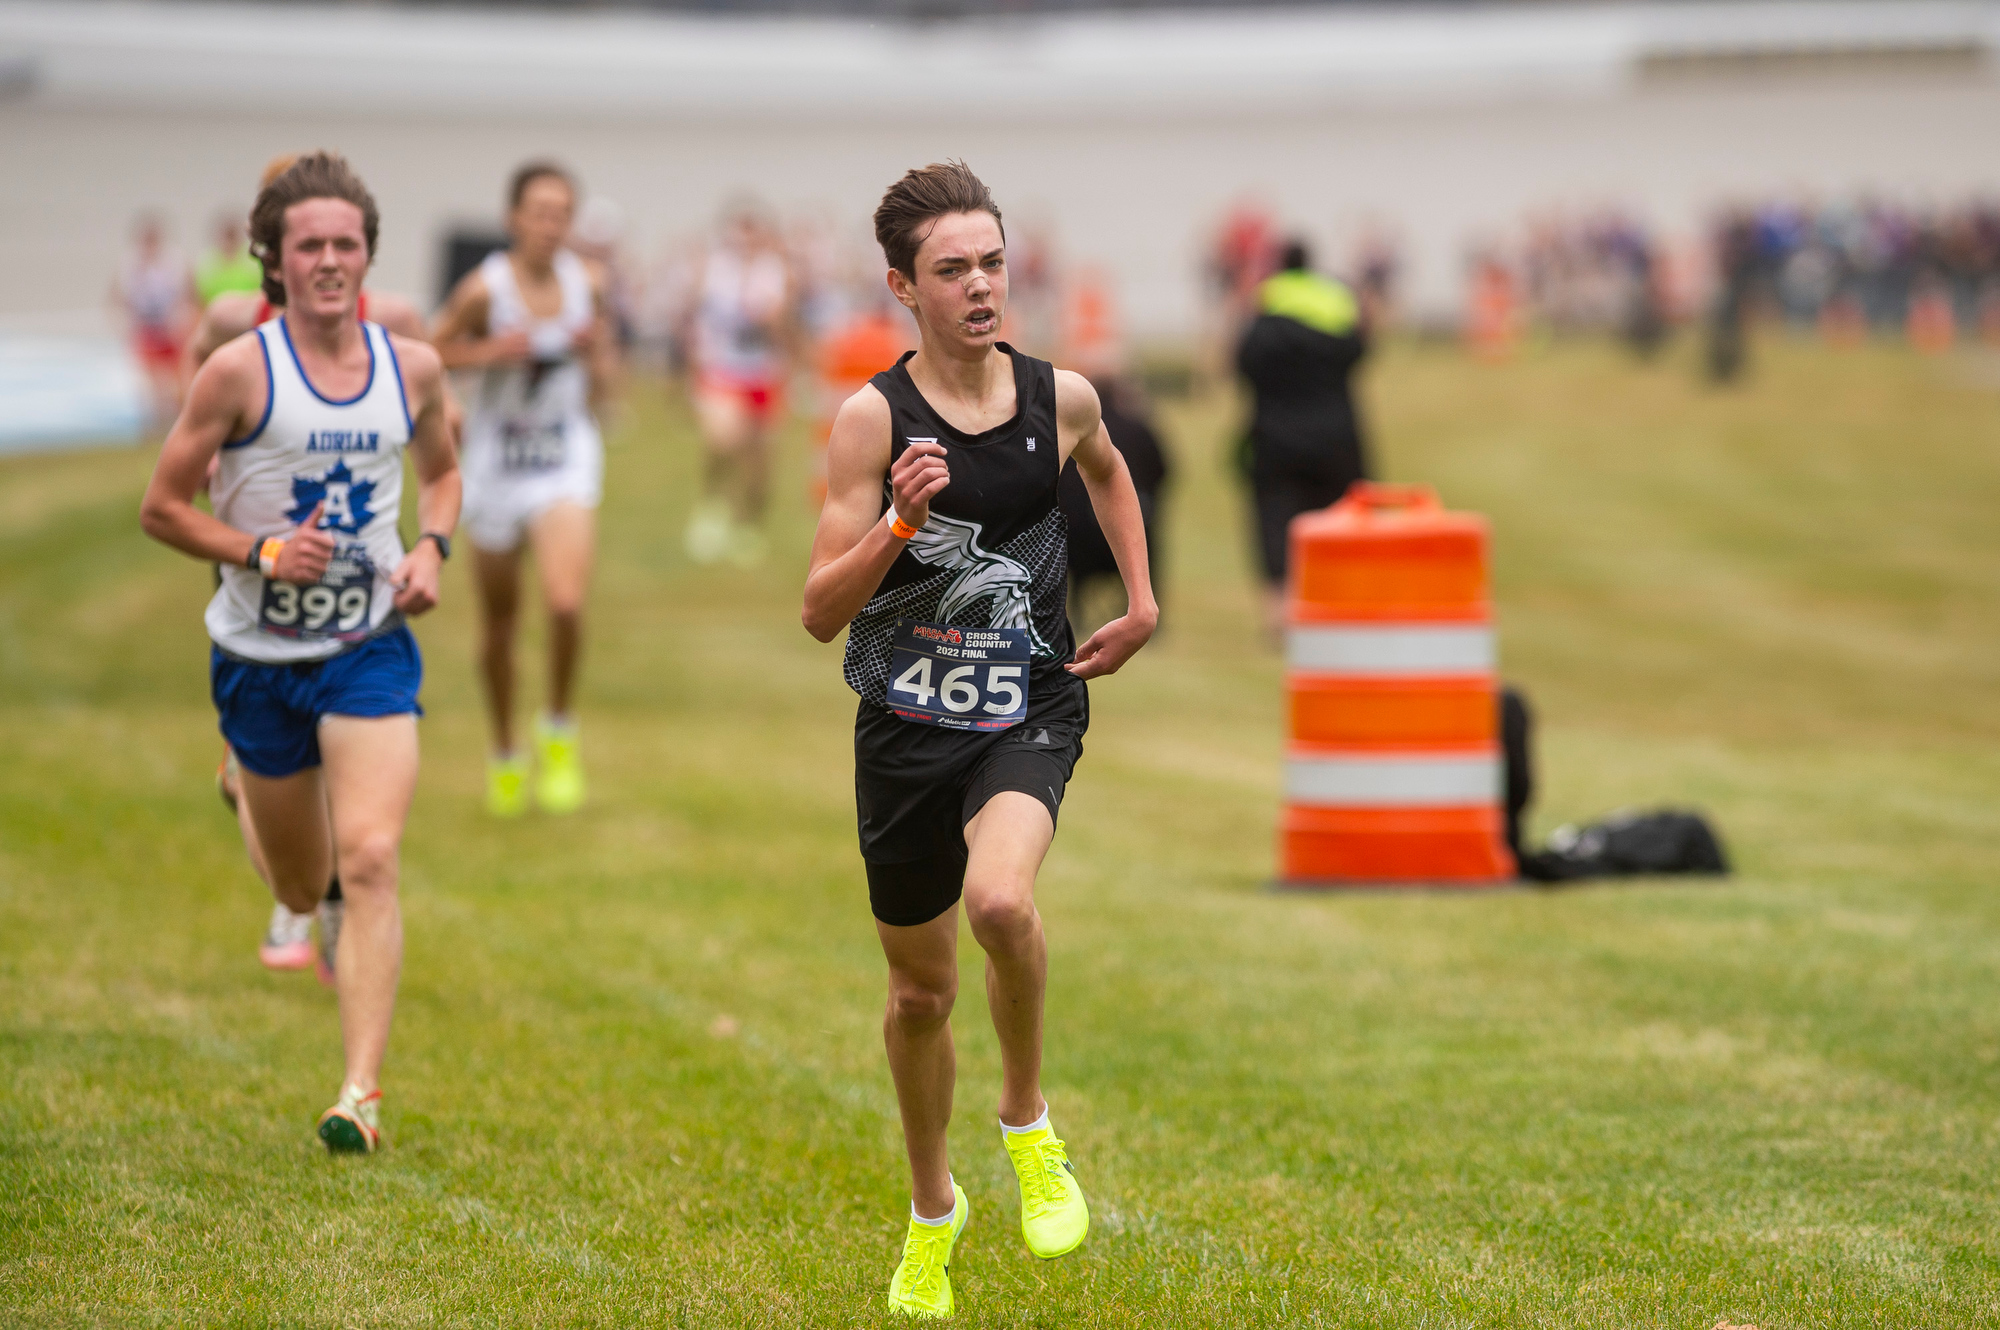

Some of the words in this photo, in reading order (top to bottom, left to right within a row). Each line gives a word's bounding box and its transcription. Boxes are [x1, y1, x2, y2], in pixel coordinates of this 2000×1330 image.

[307, 430, 379, 453] ADRIAN
[319, 481, 355, 527] A
[264, 581, 368, 631] 399
[965, 640, 1012, 648] COUNTRY
[966, 632, 1000, 640] CROSS
[936, 646, 959, 657] 2022
[961, 650, 988, 659] FINAL
[893, 657, 1023, 715] 465
